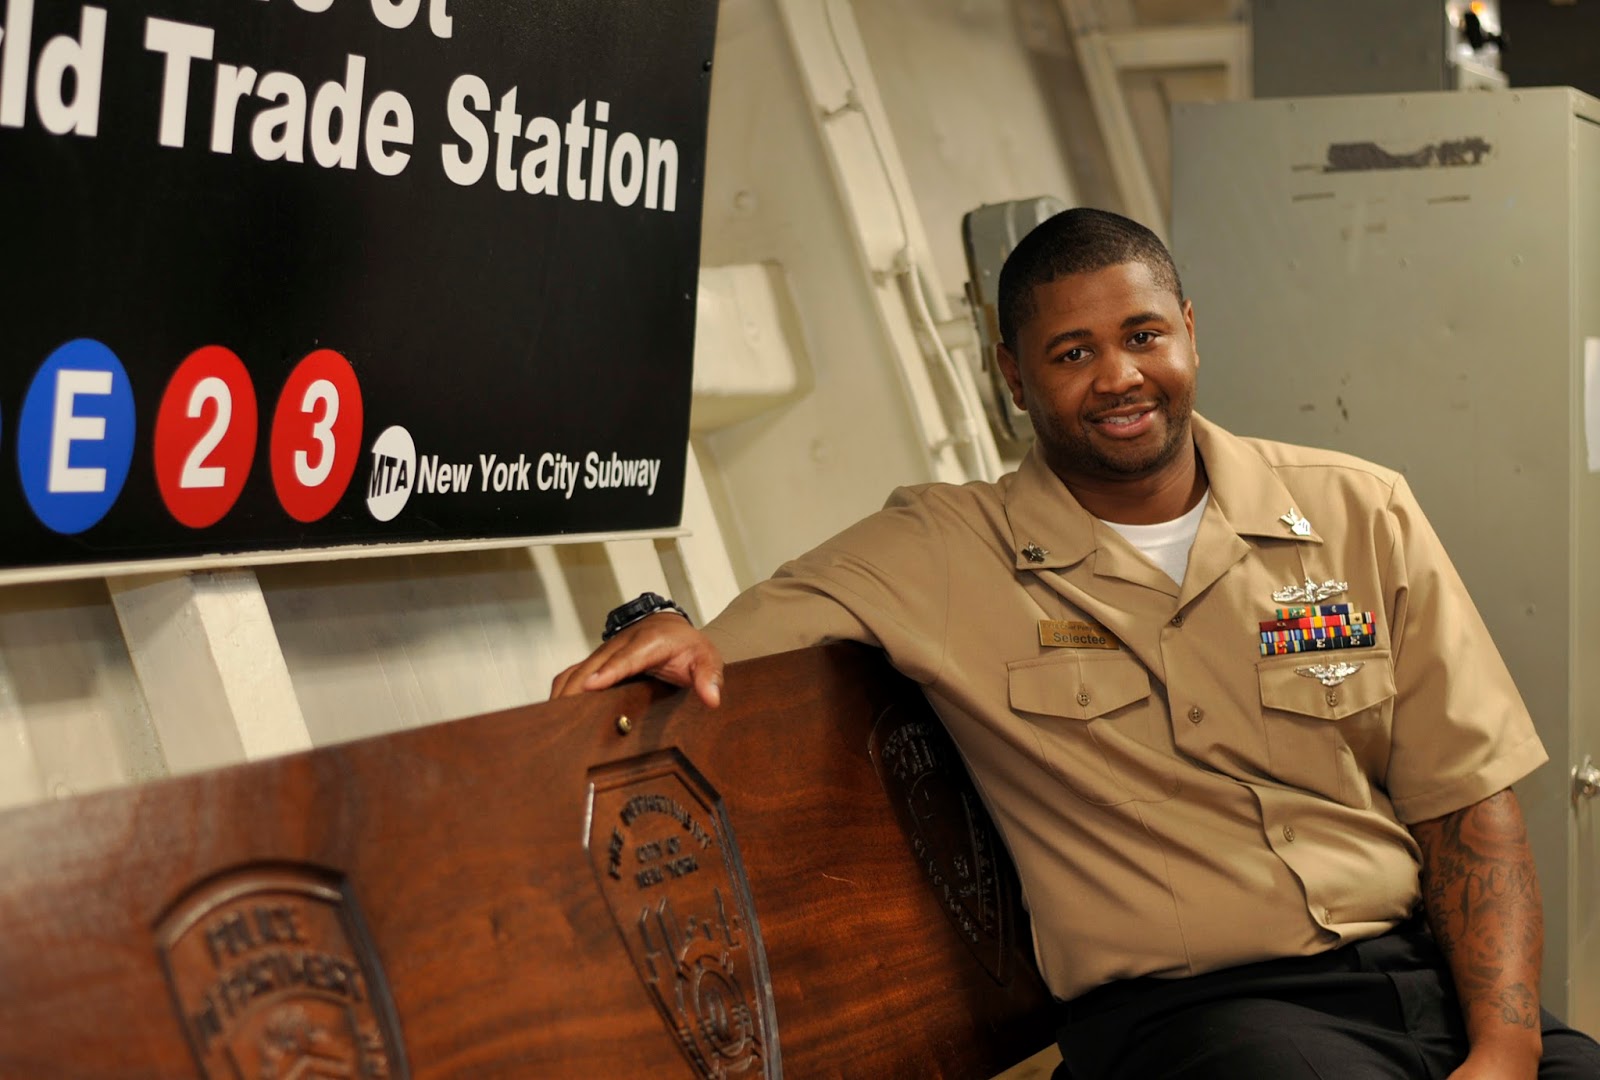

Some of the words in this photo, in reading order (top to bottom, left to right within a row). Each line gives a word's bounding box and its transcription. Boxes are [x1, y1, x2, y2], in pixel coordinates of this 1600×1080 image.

[144, 17, 414, 176] Trade
[441, 74, 679, 212] Station
[48, 369, 113, 493] E
[180, 376, 232, 489] 2
[294, 379, 340, 487] 3
[369, 451, 409, 499] MTA
[417, 455, 473, 494] New
[479, 453, 532, 492] York
[536, 452, 580, 500] City
[583, 451, 661, 496] Subway
[1053, 633, 1106, 645] Selectee
